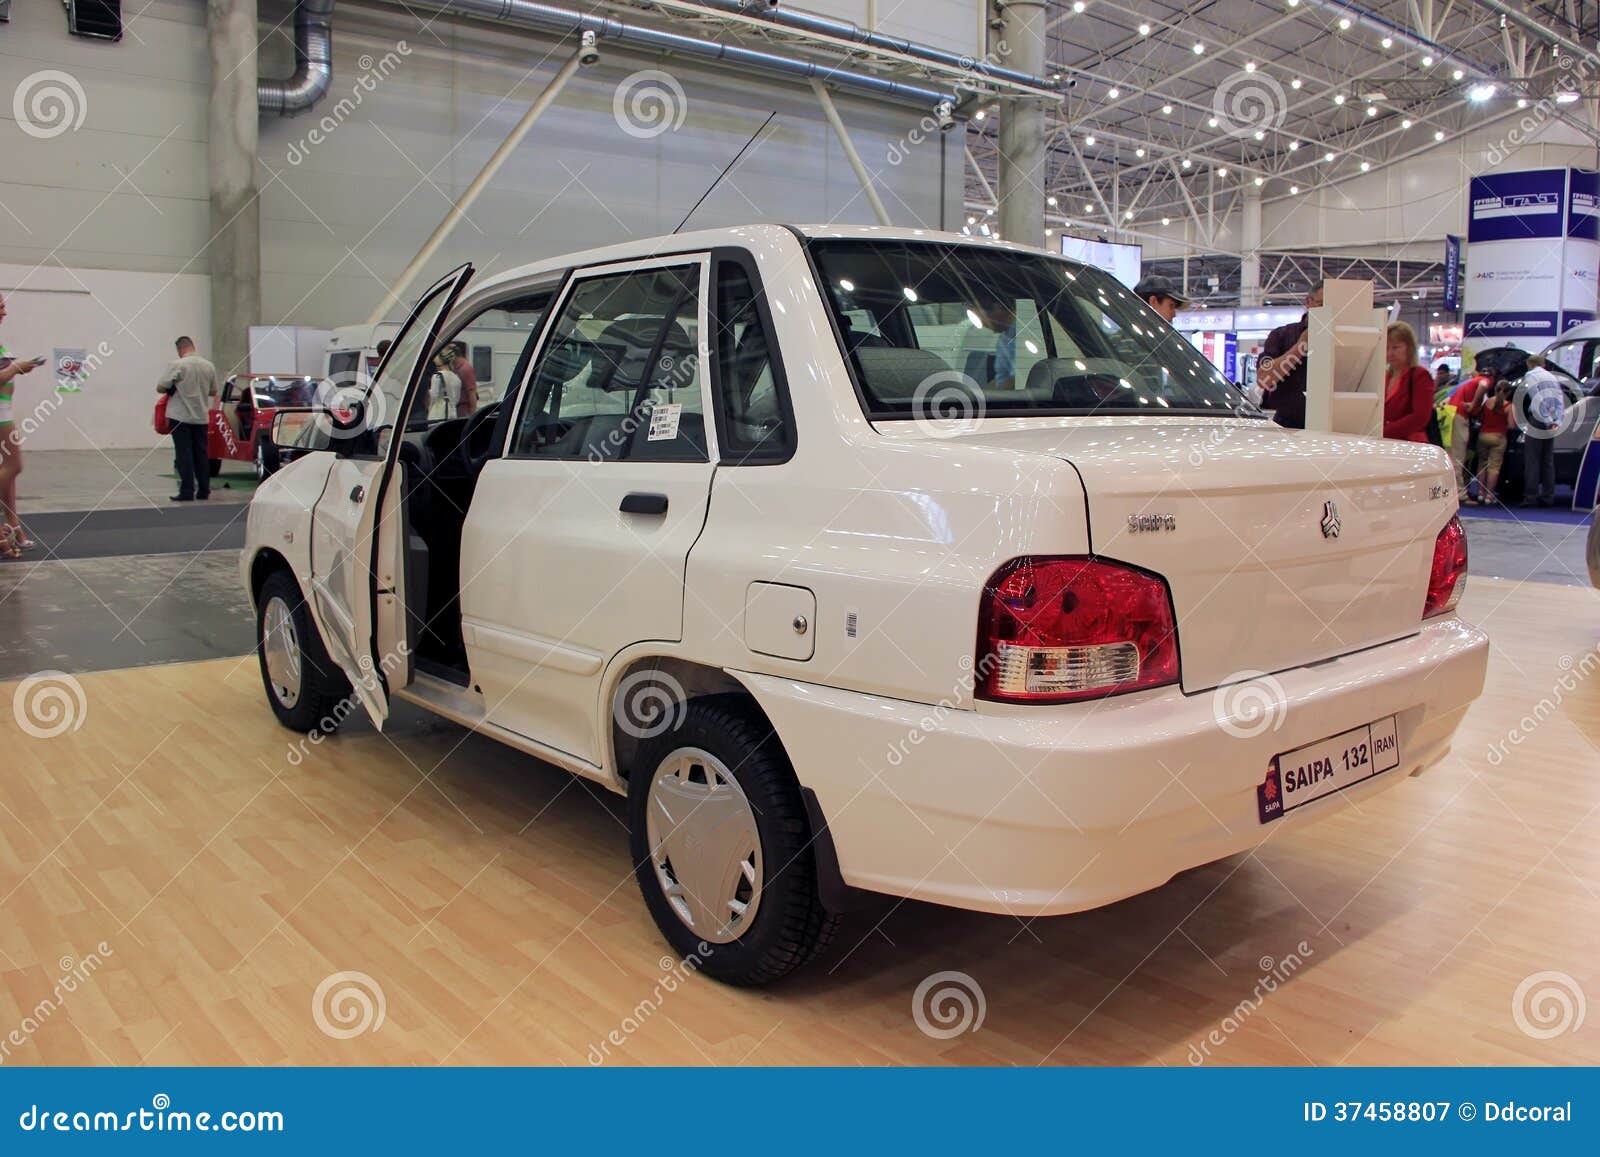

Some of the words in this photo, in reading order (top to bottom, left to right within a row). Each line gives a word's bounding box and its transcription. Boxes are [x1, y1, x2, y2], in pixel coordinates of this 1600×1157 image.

[1373, 734, 1395, 755] IRAN
[1284, 756, 1335, 794] SAIPA
[1342, 743, 1369, 771] 132
[1264, 801, 1281, 814] SAIPA
